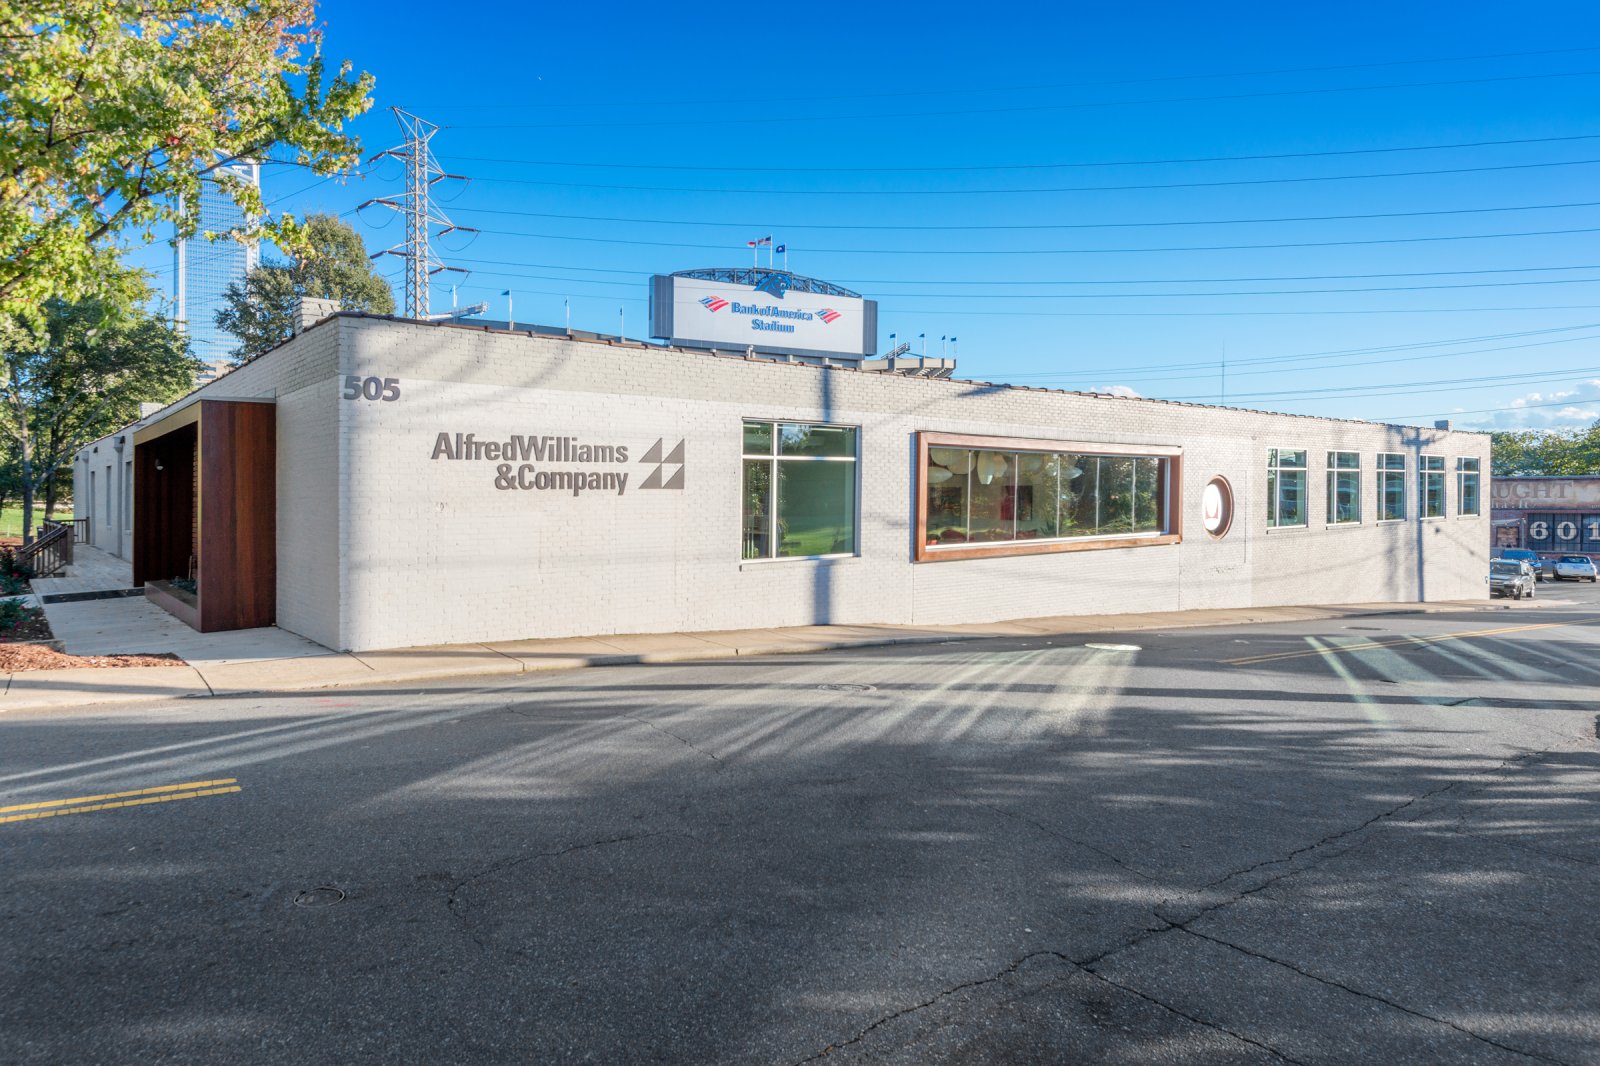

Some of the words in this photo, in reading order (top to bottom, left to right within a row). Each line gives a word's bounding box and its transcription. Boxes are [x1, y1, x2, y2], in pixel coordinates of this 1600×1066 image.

[751, 318, 795, 333] Stadium
[343, 375, 401, 402] 505
[494, 463, 629, 497] &Company
[1490, 482, 1573, 499] UGHT
[1529, 521, 1600, 541] 601
